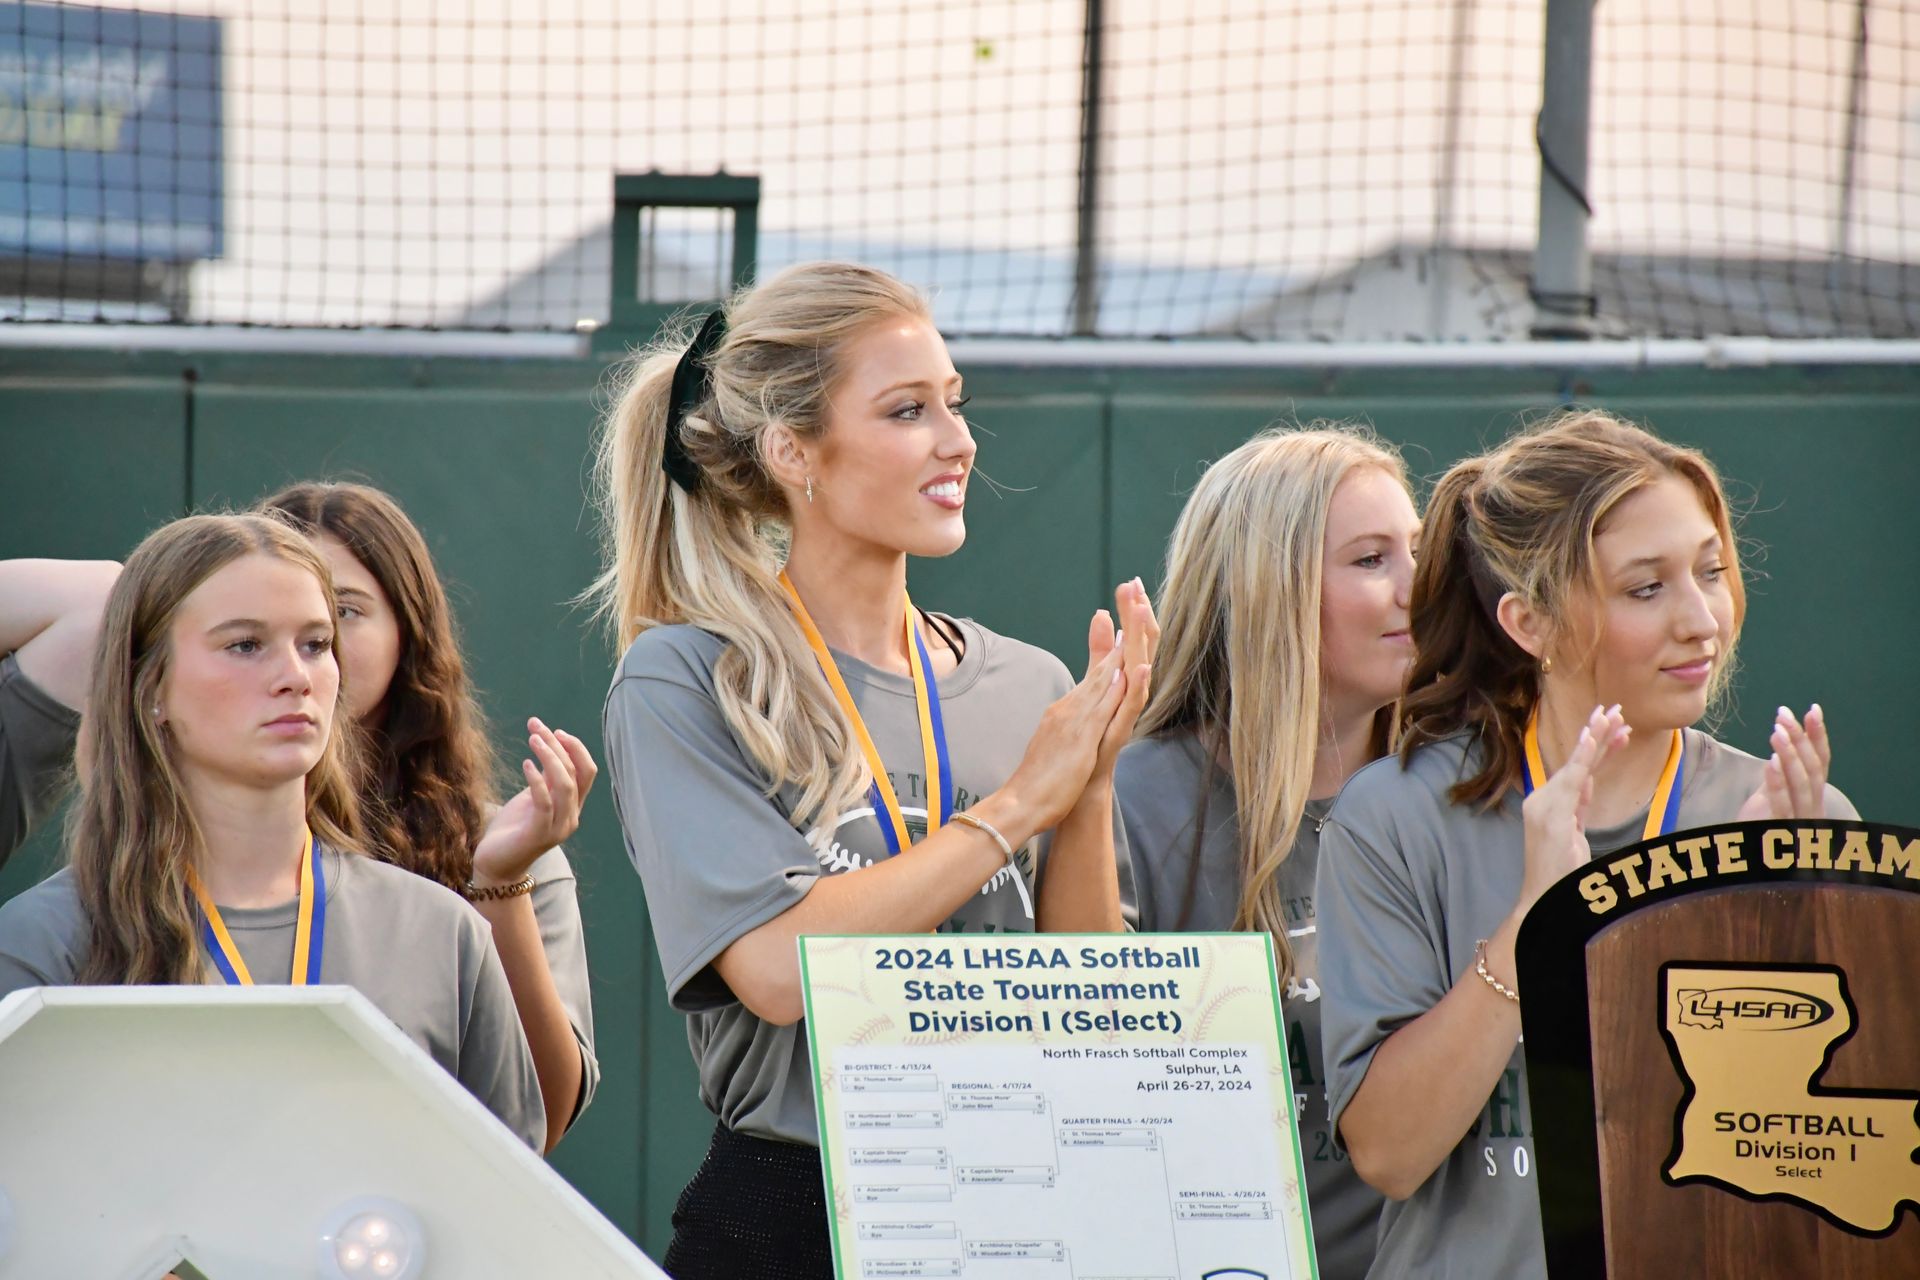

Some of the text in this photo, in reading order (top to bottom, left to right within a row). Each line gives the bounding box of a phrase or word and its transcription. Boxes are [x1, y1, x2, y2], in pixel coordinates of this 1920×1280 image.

[1578, 832, 1748, 915] STATE
[875, 947, 1200, 969] 2024 LHSAA Softball
[904, 979, 1179, 1001] State Tournament
[1691, 1000, 1816, 1020] LHSAA
[909, 1010, 1182, 1034] Division I (Select)
[1043, 1048, 1247, 1060] North Frasch Softball Complex
[1166, 1064, 1241, 1076] Sulphur, LA
[1137, 1081, 1251, 1092] April 26-27, 2024
[1714, 1112, 1884, 1138] SOFTBALL
[1735, 1140, 1856, 1162] Division I
[1775, 1165, 1822, 1179] Select
